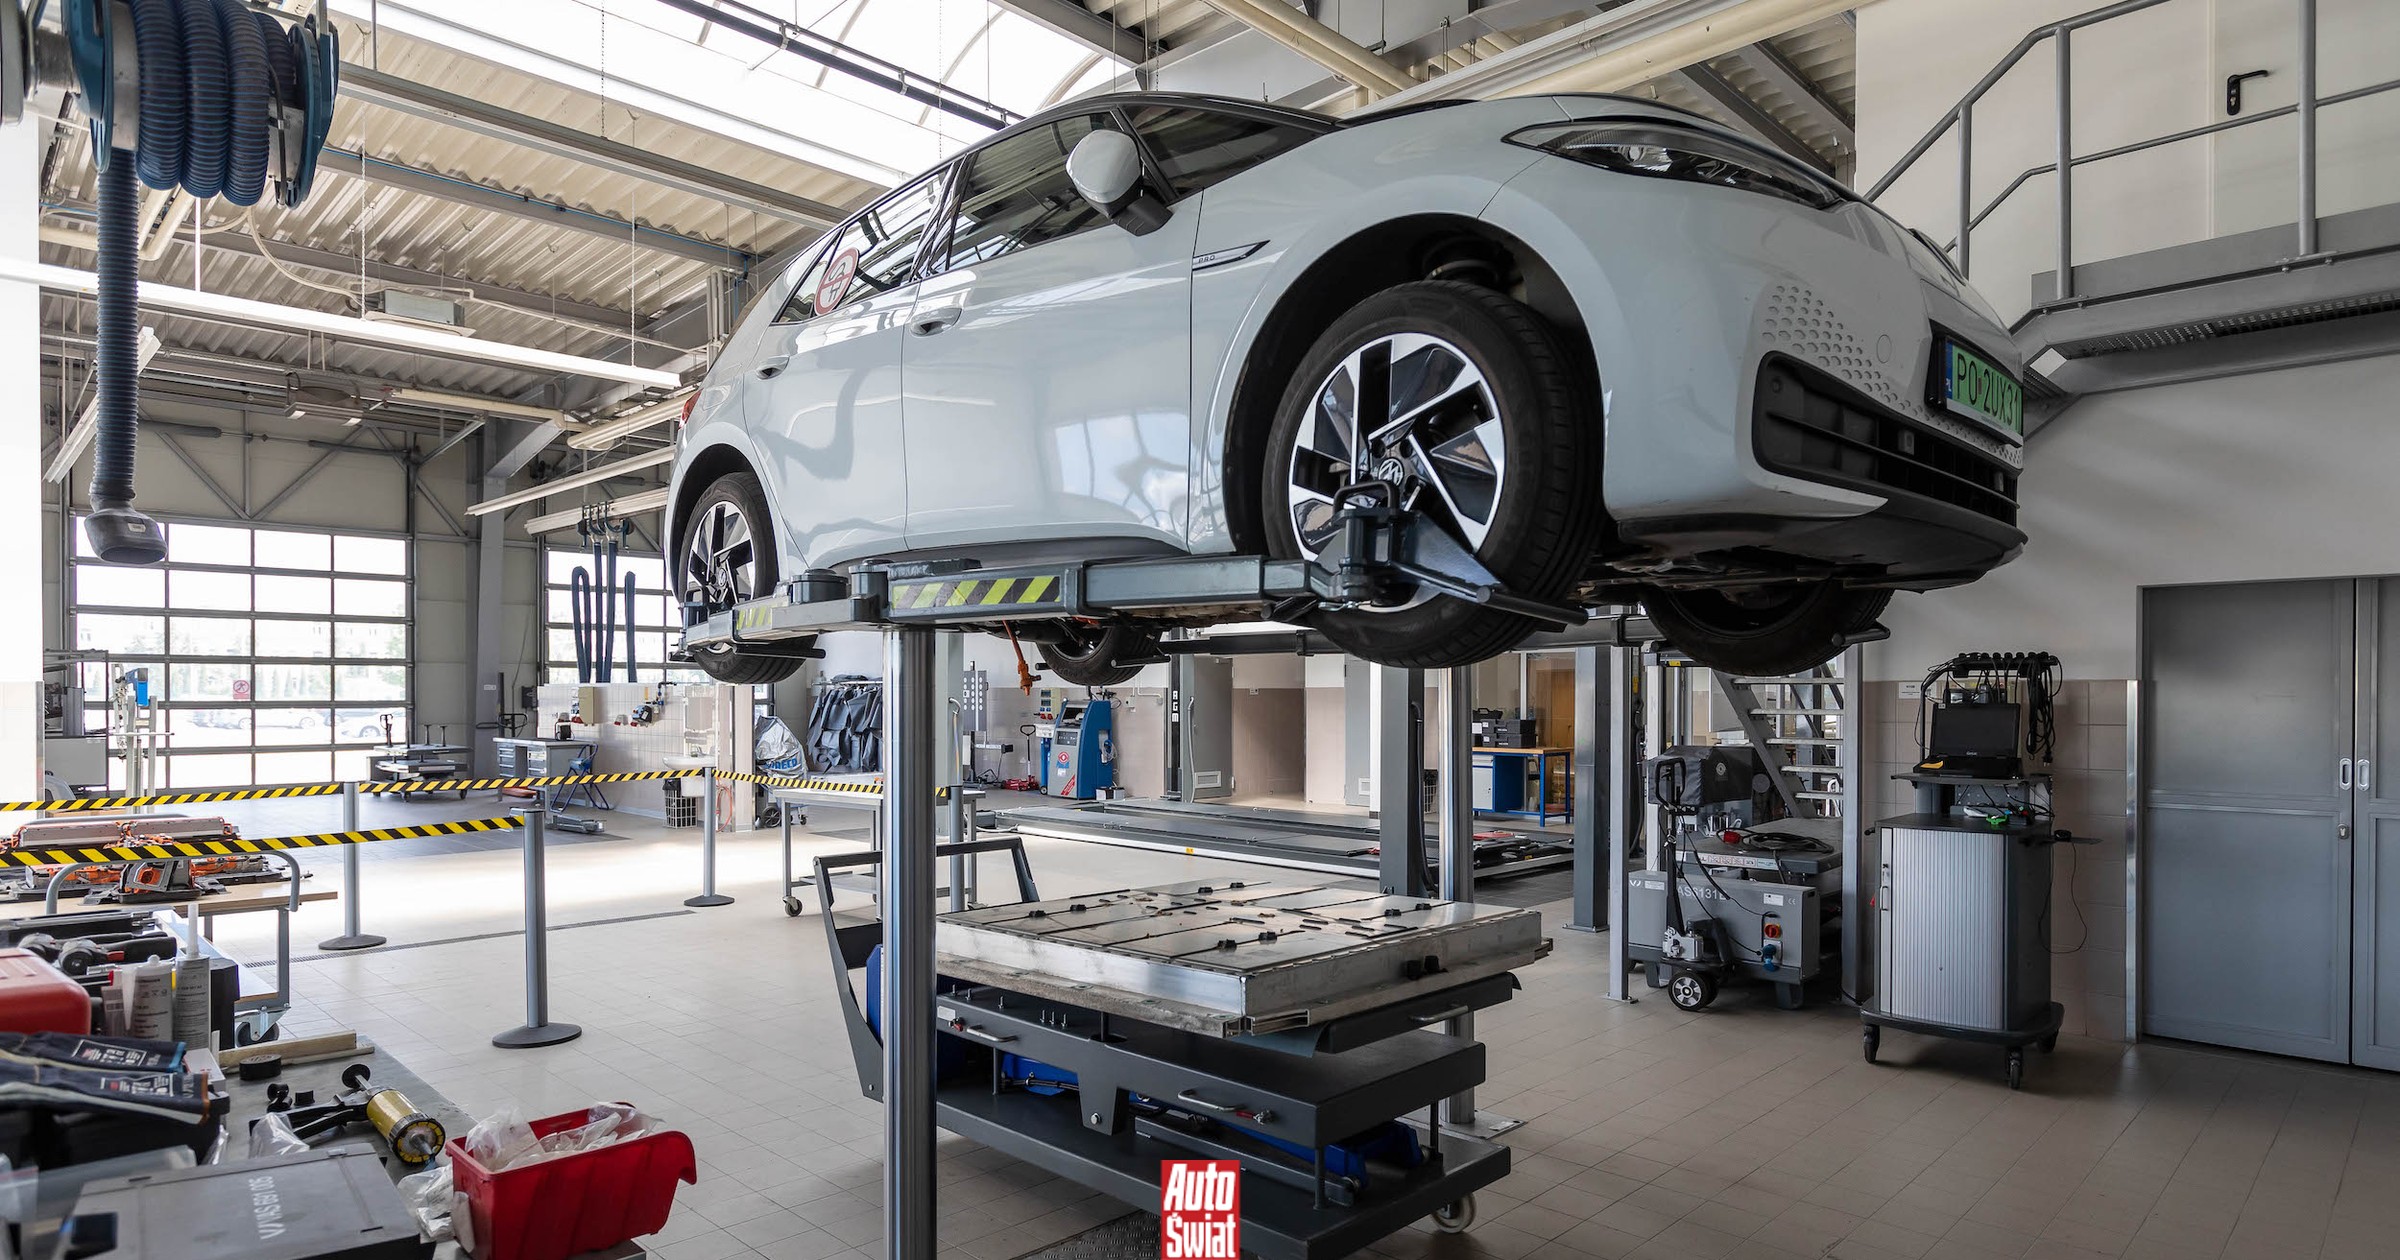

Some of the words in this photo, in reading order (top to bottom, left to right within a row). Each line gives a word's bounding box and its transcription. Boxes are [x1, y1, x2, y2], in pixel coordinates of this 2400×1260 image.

[1198, 254, 1216, 263] PRO
[1957, 352, 1978, 405] PO
[1171, 690, 1179, 723] AGM
[1677, 885, 1728, 901] AS6131
